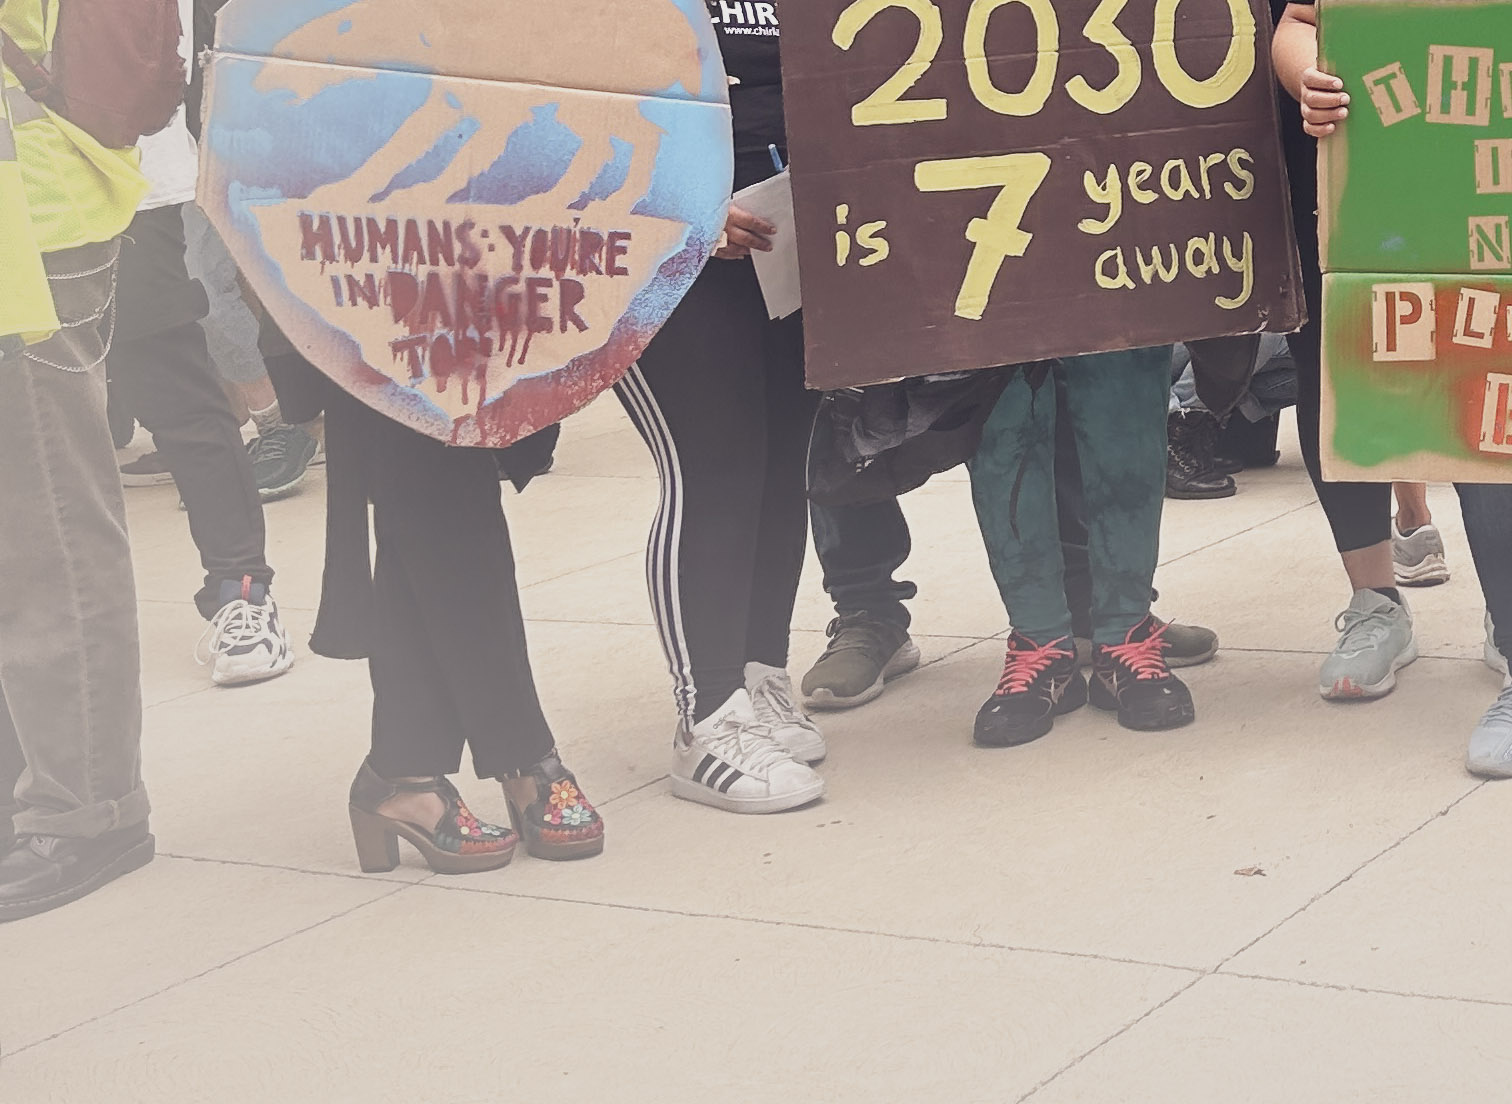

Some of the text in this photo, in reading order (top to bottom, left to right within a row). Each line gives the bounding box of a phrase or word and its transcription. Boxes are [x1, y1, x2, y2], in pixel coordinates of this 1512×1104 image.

[835, 148, 1256, 320] is 7 years
[1095, 231, 1255, 309] away
[330, 269, 589, 334] IN DANGER
